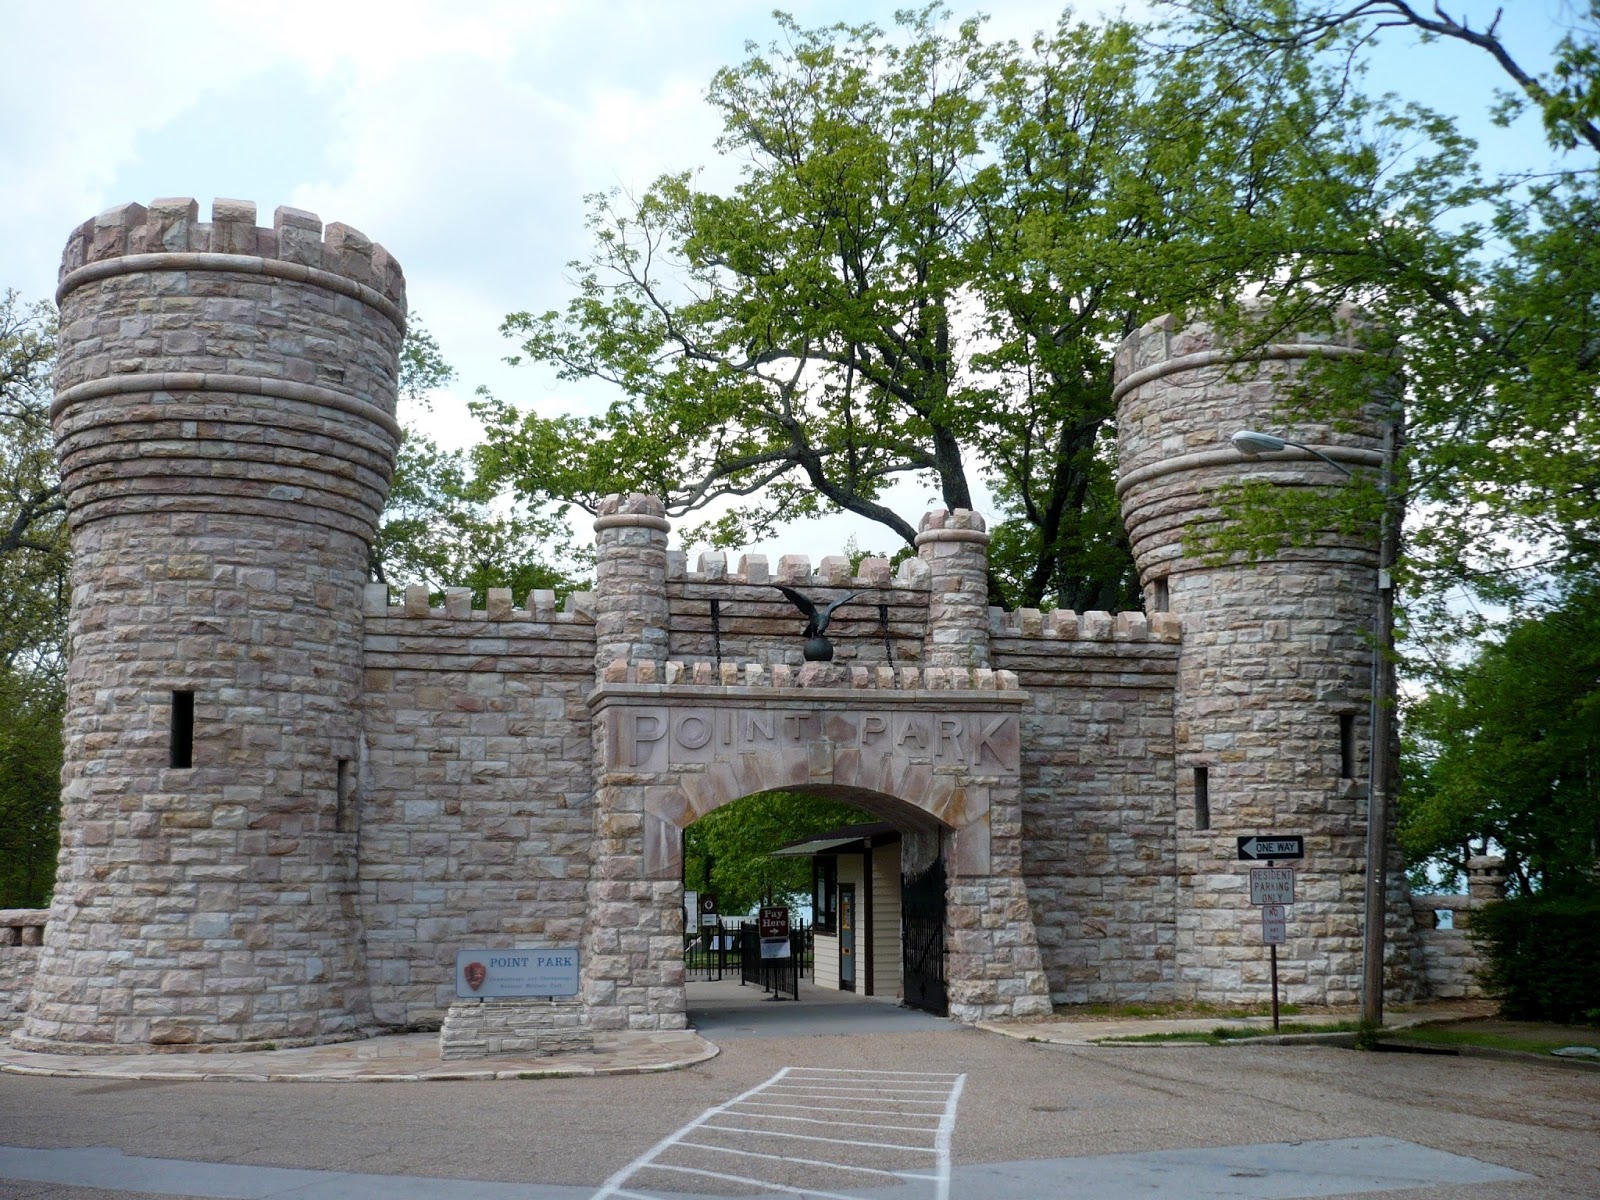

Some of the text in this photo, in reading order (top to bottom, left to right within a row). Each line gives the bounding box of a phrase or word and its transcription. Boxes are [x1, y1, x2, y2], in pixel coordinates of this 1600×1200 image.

[629, 714, 1015, 771] POINT PARK
[1256, 842, 1295, 852] ONE WAY
[1252, 870, 1291, 880] RESIDENT
[1254, 882, 1290, 892] PARKING
[1262, 893, 1283, 903] ONLY
[764, 910, 783, 919] Pay
[762, 918, 785, 927] Here
[490, 957, 572, 967] POINT PARK
